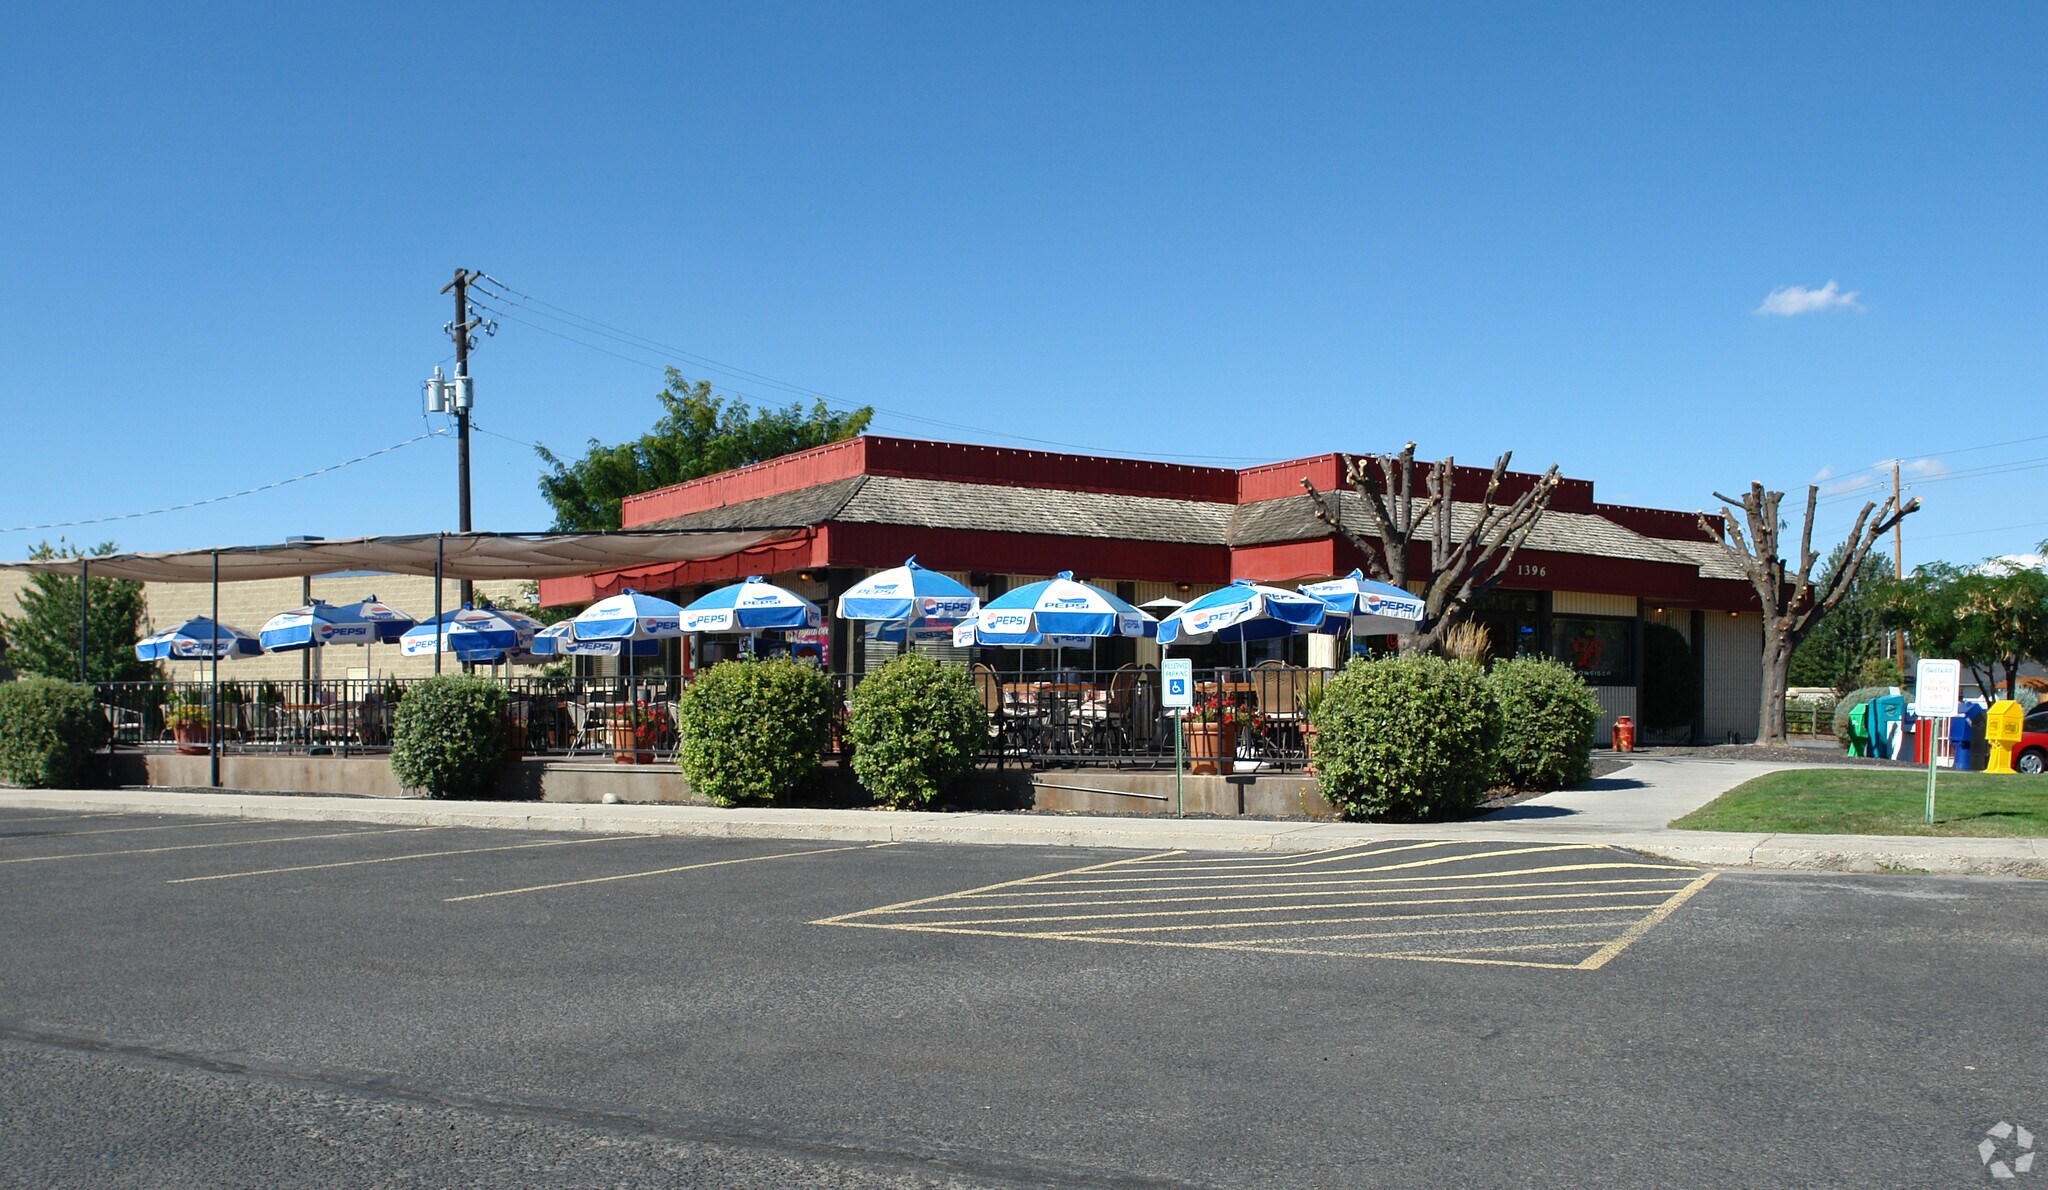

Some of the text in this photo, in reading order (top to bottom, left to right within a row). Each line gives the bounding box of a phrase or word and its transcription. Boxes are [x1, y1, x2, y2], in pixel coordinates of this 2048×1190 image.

[1517, 565, 1546, 577] 1396
[936, 602, 971, 611] PEPSI
[1379, 600, 1416, 613] PEPSI
[696, 615, 727, 623] PEPSI
[995, 616, 1027, 626] PEPSI
[331, 627, 367, 636] PEPSI
[576, 642, 613, 651] PEPSI
[1164, 662, 1188, 670] RESERVED
